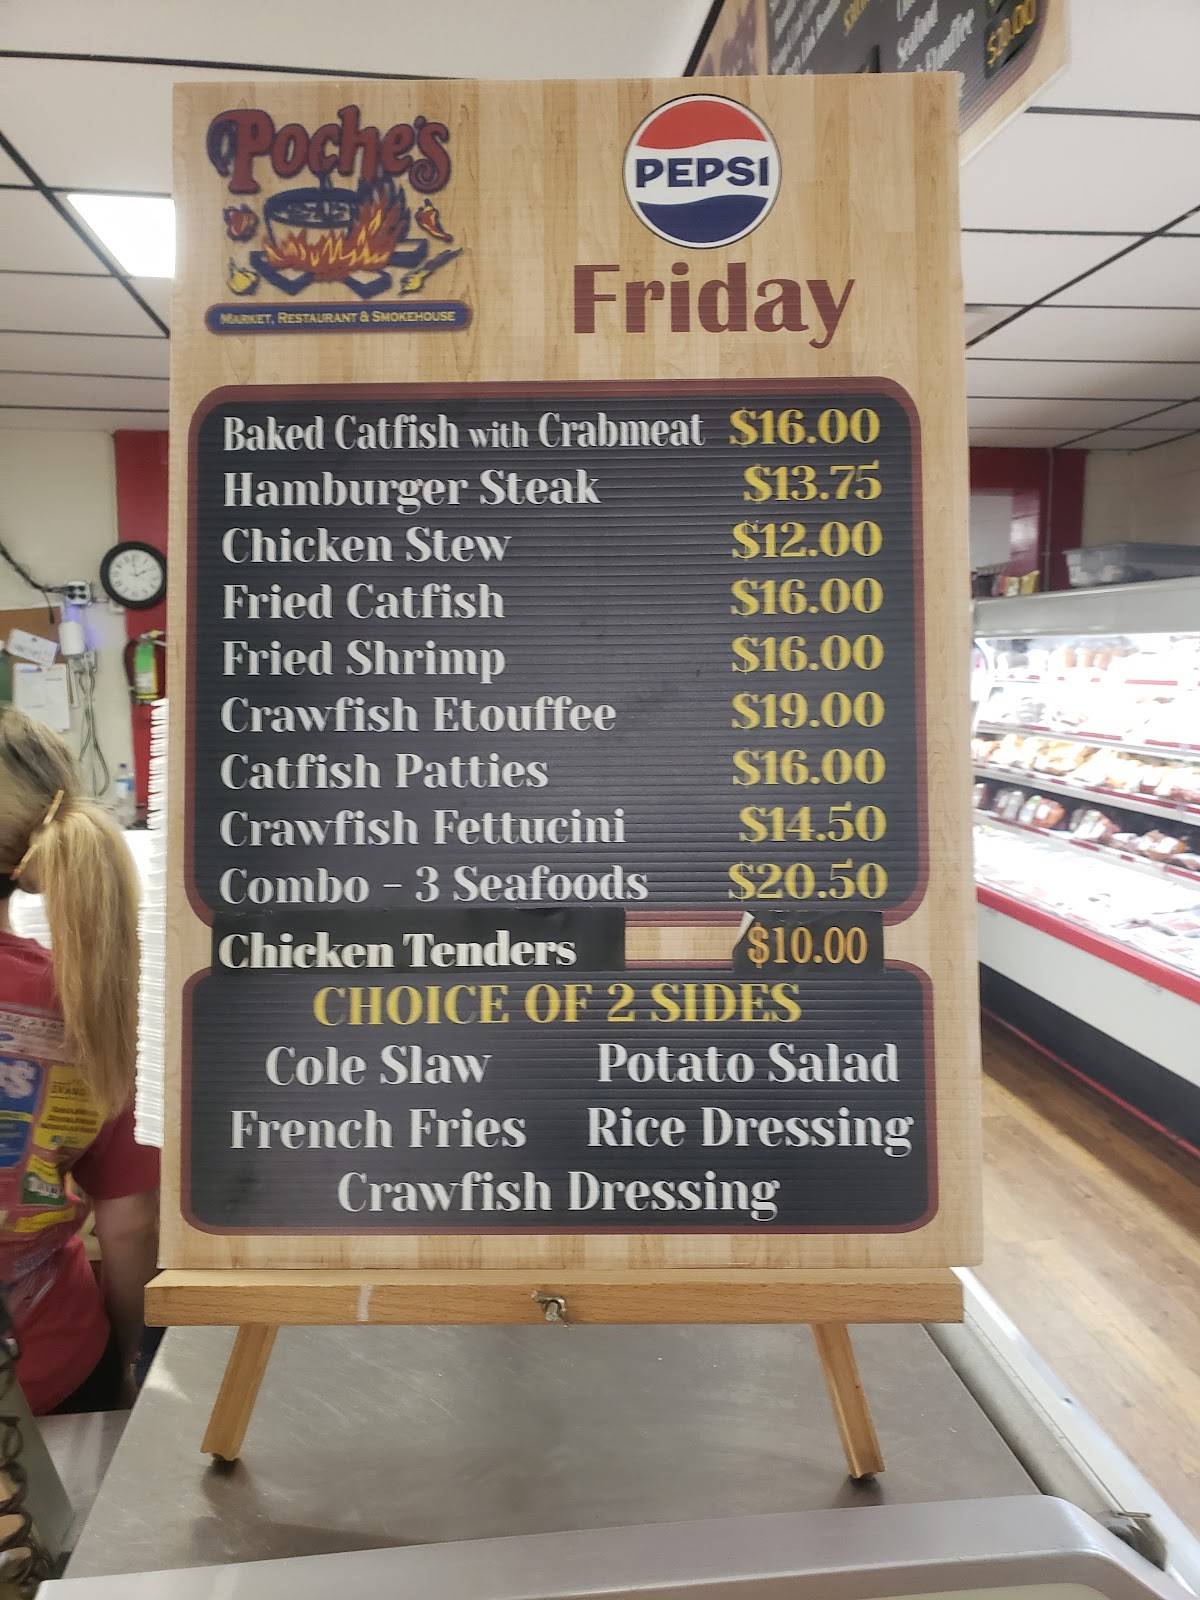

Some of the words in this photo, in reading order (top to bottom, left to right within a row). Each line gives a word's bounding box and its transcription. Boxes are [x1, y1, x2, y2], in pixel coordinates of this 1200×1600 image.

[206, 104, 452, 195] Poche's
[635, 155, 770, 189] PEPSI
[573, 261, 856, 350] Friday
[223, 415, 325, 452] Baked
[335, 413, 460, 450] Catfish
[467, 420, 529, 448] with
[538, 412, 705, 448] Crabmeat
[729, 409, 881, 445] $16.00
[223, 471, 469, 515] Hamburger
[479, 468, 602, 505] Steak
[743, 463, 881, 502] $13.75
[222, 527, 394, 564] Chicken
[405, 526, 513, 563] Stew
[732, 521, 883, 559] $12.00
[223, 583, 334, 620] Fried
[346, 582, 506, 619] Catfish
[731, 577, 883, 615] $16.00
[223, 640, 334, 676] Fried
[346, 639, 506, 685] Shrimp
[732, 635, 884, 672] $16.00
[221, 696, 420, 733] Crawfish
[432, 695, 617, 732] Etouffee
[732, 691, 885, 728] $19.00
[220, 753, 382, 790] Catfish
[394, 752, 549, 789] Patties
[733, 749, 885, 785] $16.00
[221, 809, 420, 847] Crawfish
[432, 807, 627, 845] Fettucini
[740, 804, 886, 842] $14.50
[220, 867, 370, 905] Combo
[415, 865, 440, 903] 3
[452, 862, 650, 904] Seafoods
[729, 861, 888, 899] $20.50
[219, 931, 395, 969] Chicken
[402, 929, 577, 968] Tenders
[746, 923, 868, 967] $10.00
[313, 984, 509, 1025] CHOICE
[524, 983, 593, 1024] OF
[607, 983, 636, 1023] 2
[651, 983, 801, 1023] SIDES
[265, 1046, 367, 1086] Cole
[379, 1044, 493, 1085] Slaw
[597, 1043, 755, 1083] Potato
[768, 1042, 901, 1083] Salad
[230, 1109, 395, 1150] French
[408, 1107, 527, 1148] Fries
[586, 1106, 686, 1147] Rice
[701, 1106, 915, 1158] Dressing
[337, 1170, 553, 1213] Crawfish
[567, 1170, 781, 1222] Dressing
